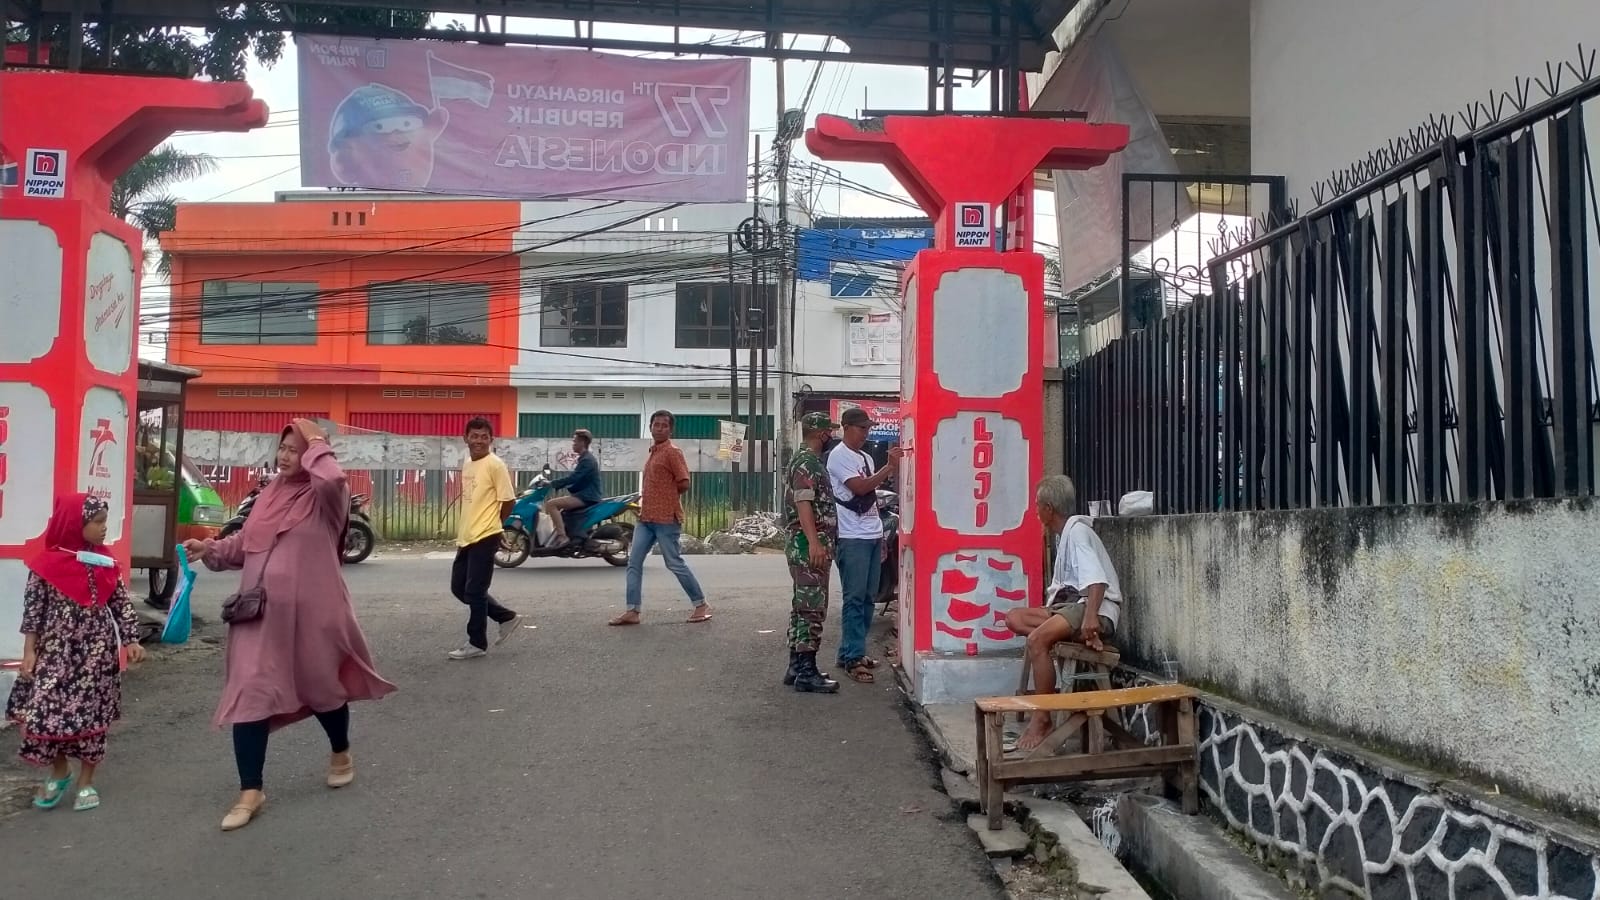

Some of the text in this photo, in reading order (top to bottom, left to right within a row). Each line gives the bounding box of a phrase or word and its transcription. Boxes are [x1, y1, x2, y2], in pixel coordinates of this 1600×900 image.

[25, 179, 64, 188] NIPPON
[27, 187, 58, 195] PAINT
[973, 417, 994, 528] LOJI
